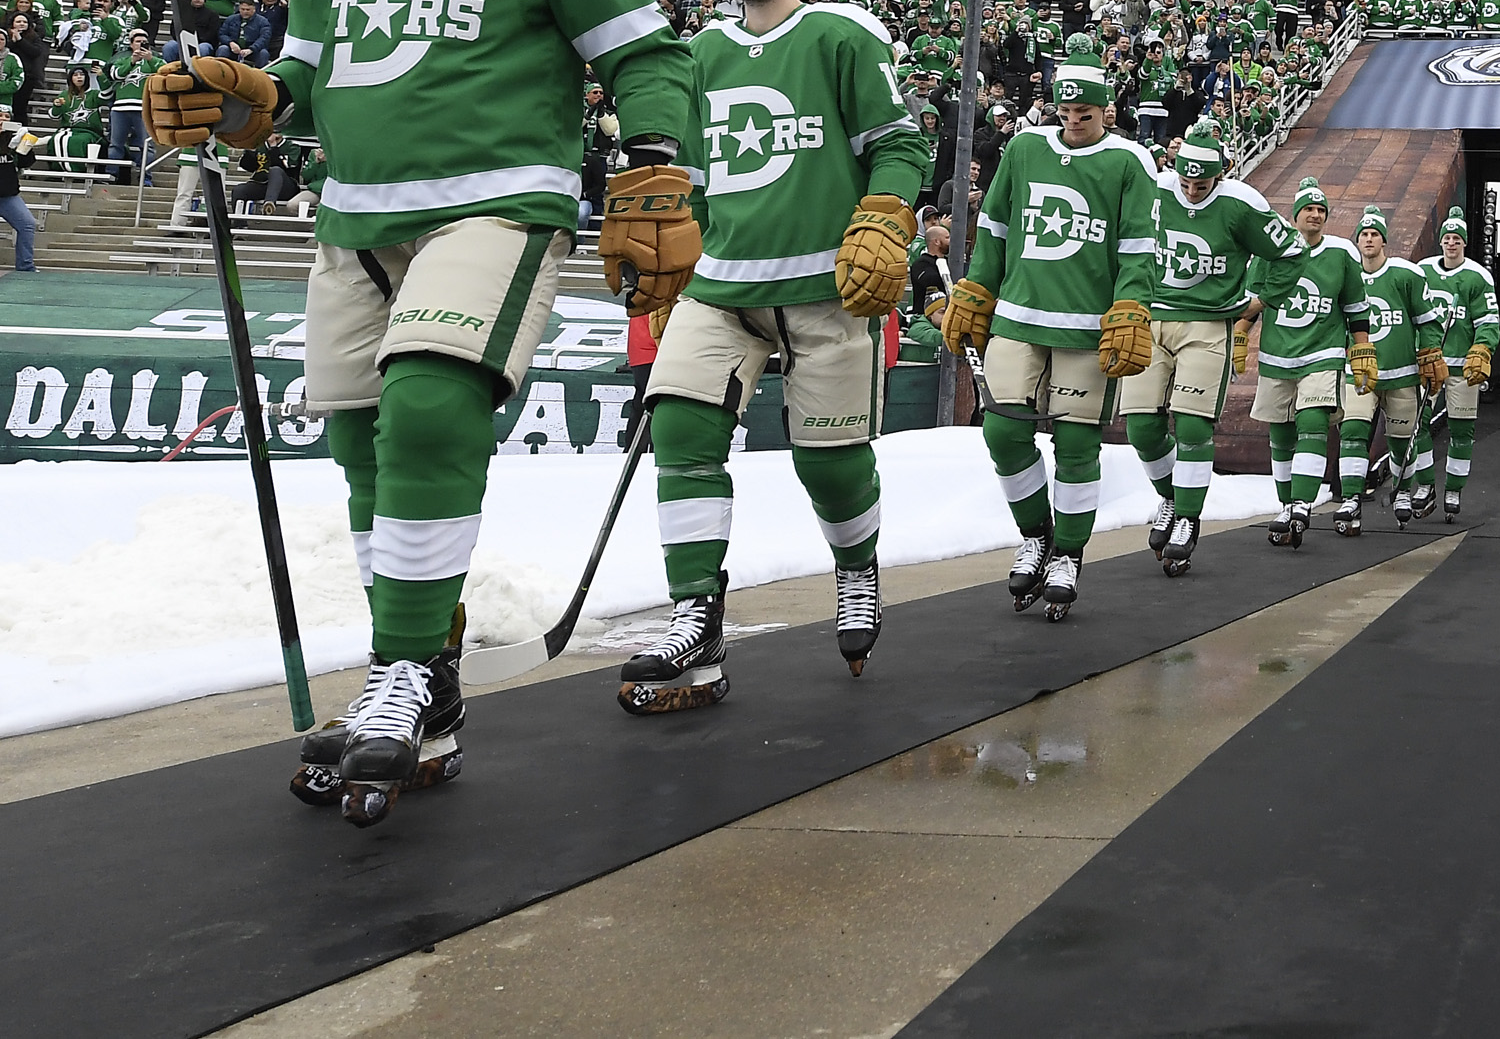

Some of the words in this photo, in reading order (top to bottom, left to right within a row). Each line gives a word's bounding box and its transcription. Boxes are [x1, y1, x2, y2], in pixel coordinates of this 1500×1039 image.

[391, 306, 486, 333] BAUER
[965, 346, 985, 377] CCM
[1173, 384, 1205, 396] CCM
[1303, 395, 1336, 405] BAUER
[5, 365, 325, 446] DALLAS
[802, 413, 869, 428] BAUER
